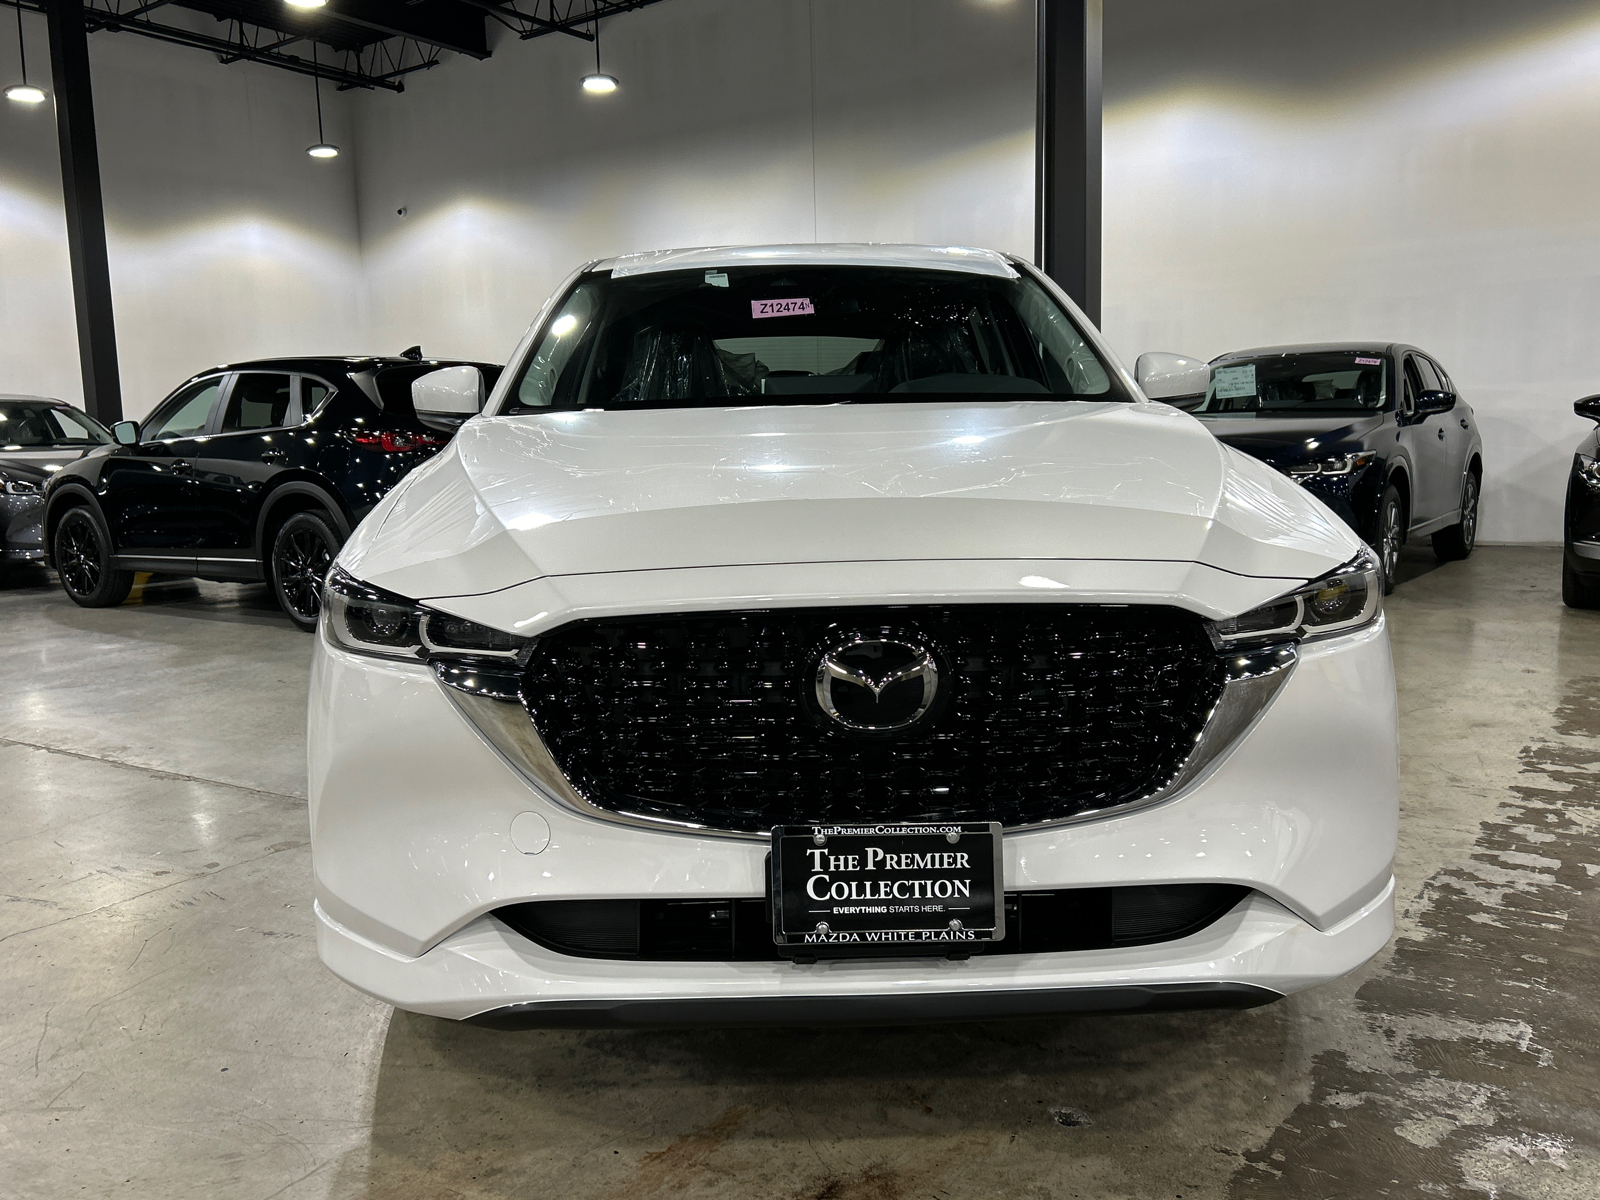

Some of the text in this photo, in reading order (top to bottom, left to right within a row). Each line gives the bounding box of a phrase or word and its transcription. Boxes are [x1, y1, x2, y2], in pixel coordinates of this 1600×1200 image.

[806, 847, 971, 872] THE PREMIER
[806, 874, 971, 901] COLLECTION
[833, 904, 946, 914] EVERYTHING STARTS HERE.
[804, 930, 976, 943] MAZDA WHITE PLAINS
